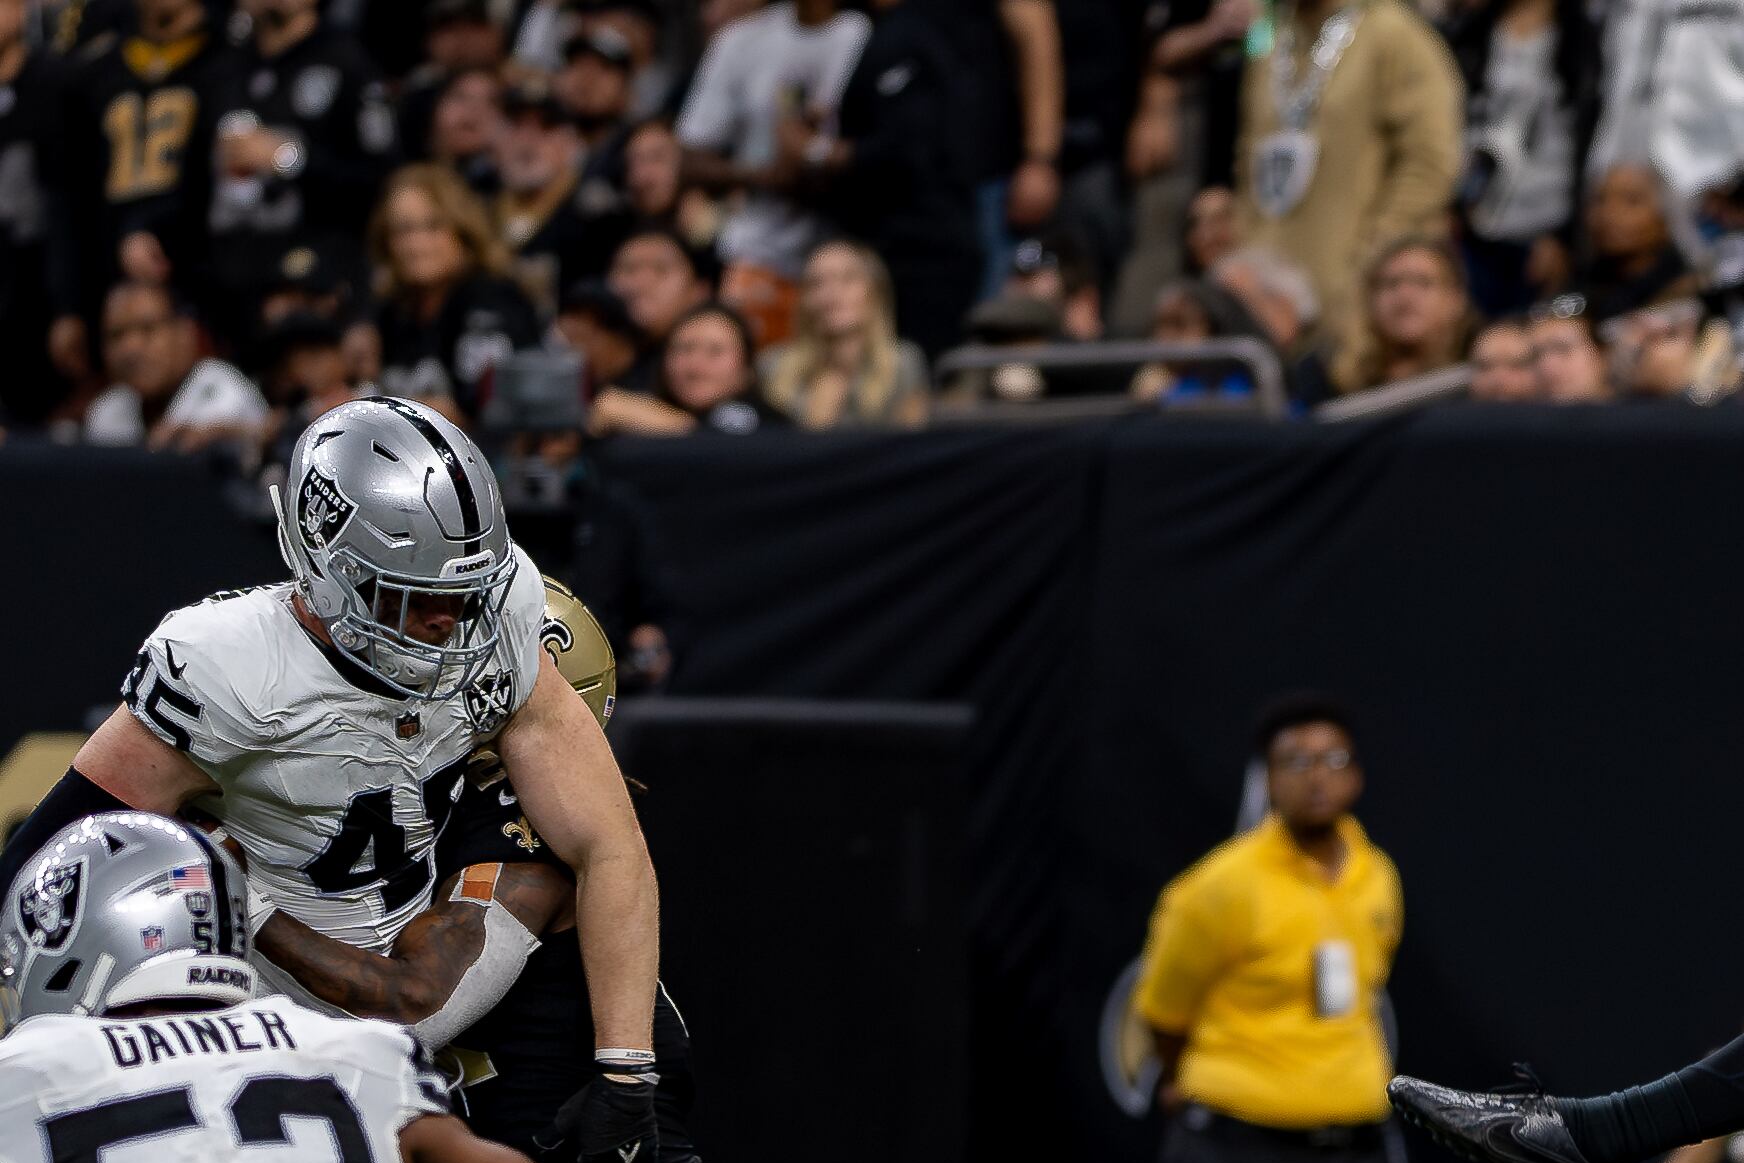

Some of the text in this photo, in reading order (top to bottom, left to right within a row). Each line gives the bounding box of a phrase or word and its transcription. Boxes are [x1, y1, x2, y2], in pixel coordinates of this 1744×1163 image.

[103, 89, 196, 201] 12
[310, 471, 348, 513] RAIDERS
[455, 557, 491, 575] RAIDERS
[102, 1011, 298, 1068] GAINER
